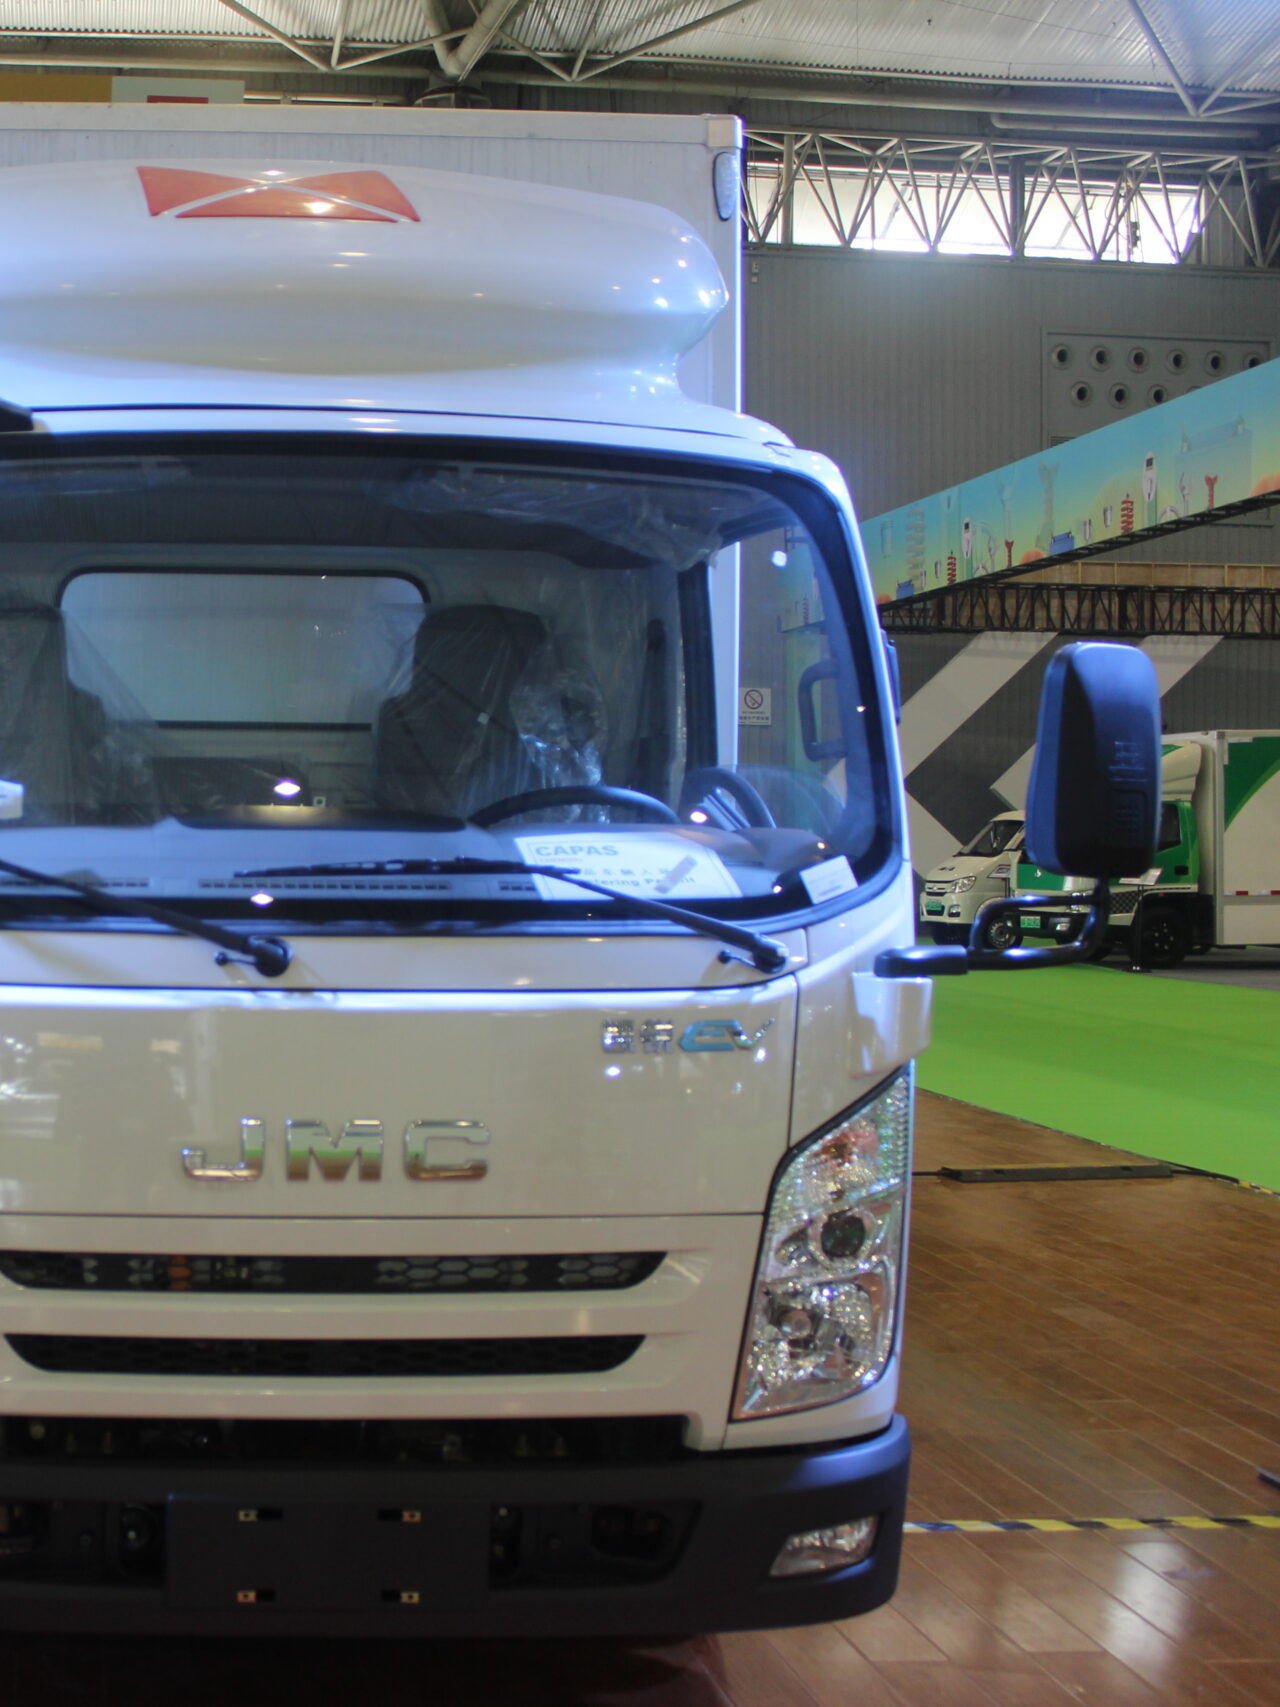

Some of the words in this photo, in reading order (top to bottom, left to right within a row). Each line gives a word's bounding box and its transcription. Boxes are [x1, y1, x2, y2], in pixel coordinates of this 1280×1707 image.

[535, 845, 619, 856] CAPAS
[679, 1017, 776, 1052] EV
[182, 1118, 491, 1182] JMC
